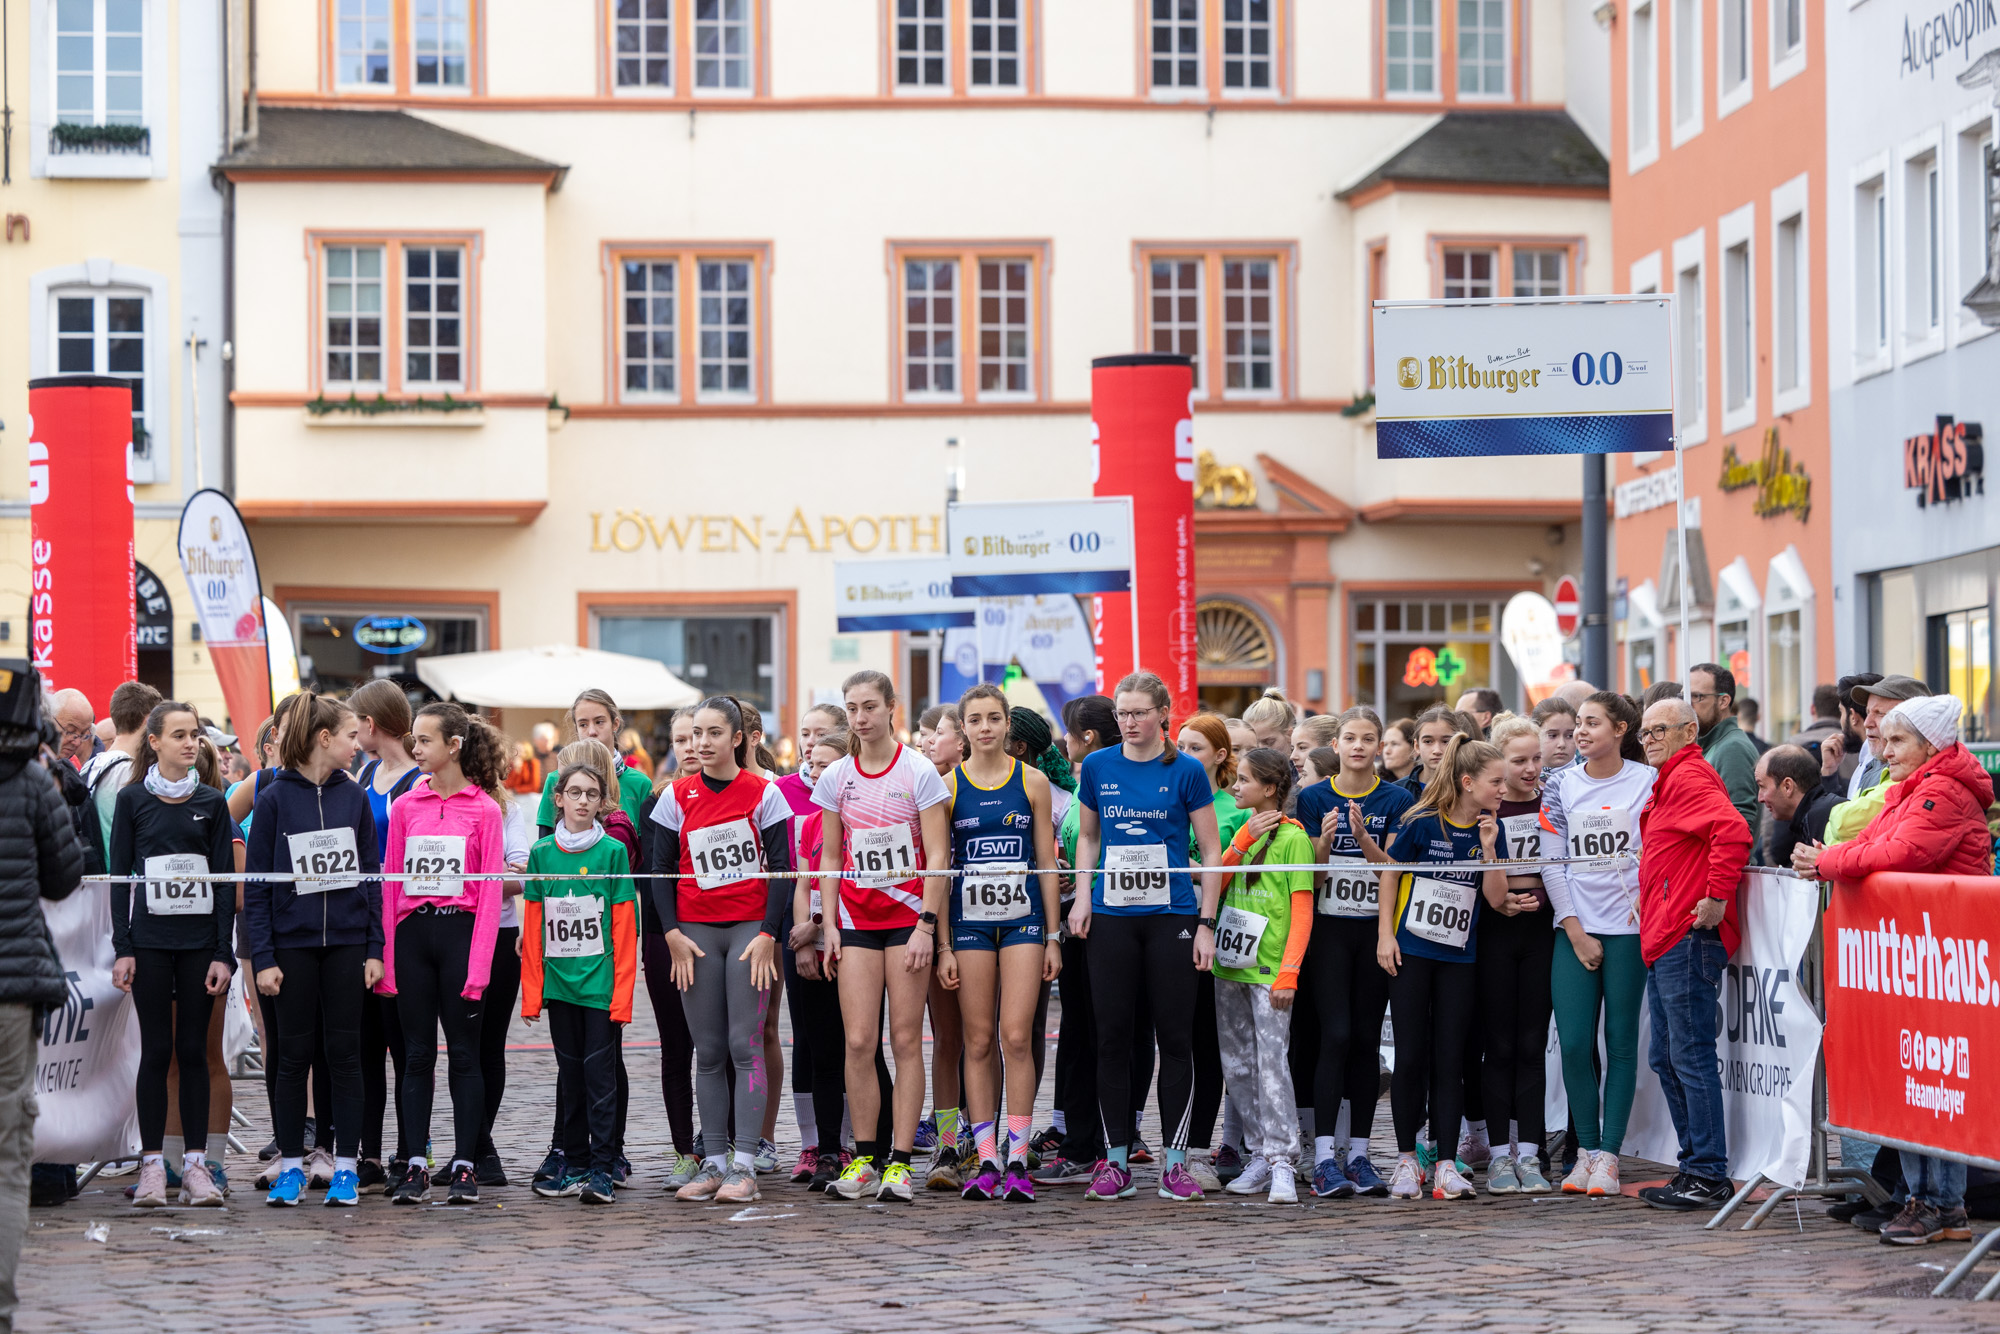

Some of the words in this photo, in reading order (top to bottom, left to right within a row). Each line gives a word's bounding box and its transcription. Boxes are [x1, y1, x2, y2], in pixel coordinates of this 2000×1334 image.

[1427, 355, 1541, 393] Bitburger
[1571, 351, 1623, 386] 0.0
[1903, 414, 1967, 504] KRASS
[590, 506, 942, 553] LÖWEN-APOTH
[982, 536, 1050, 558] Bitburger
[186, 547, 245, 579] Bitburger
[1177, 548, 1188, 578] Geld
[860, 584, 914, 603] Bitburger
[1015, 814, 1031, 824] PST
[1103, 805, 1168, 820] LGVulkaneifel
[1371, 816, 1387, 824] PST
[695, 840, 756, 873] 1636
[981, 841, 1017, 855] SWT
[1571, 831, 1630, 858] 1602
[296, 849, 357, 874] 1622
[405, 857, 461, 874] 1623
[855, 845, 910, 871] 1611
[1107, 867, 1167, 891] 1609
[1446, 870, 1475, 881] SWT
[149, 881, 208, 900] 1621
[966, 883, 1027, 906] 1634
[1324, 876, 1380, 904] 1605
[170, 902, 193, 910] alsecon
[1414, 900, 1471, 932] 1608
[547, 917, 599, 942] 1645
[1215, 926, 1258, 957] 1647
[1426, 930, 1449, 939] alsecon
[1837, 911, 2000, 1008] mutterhaus.
[36, 1058, 82, 1095] MENTE
[1717, 1058, 1792, 1098] RMENGRUPPE
[1905, 1074, 1965, 1122] #teamplayer
